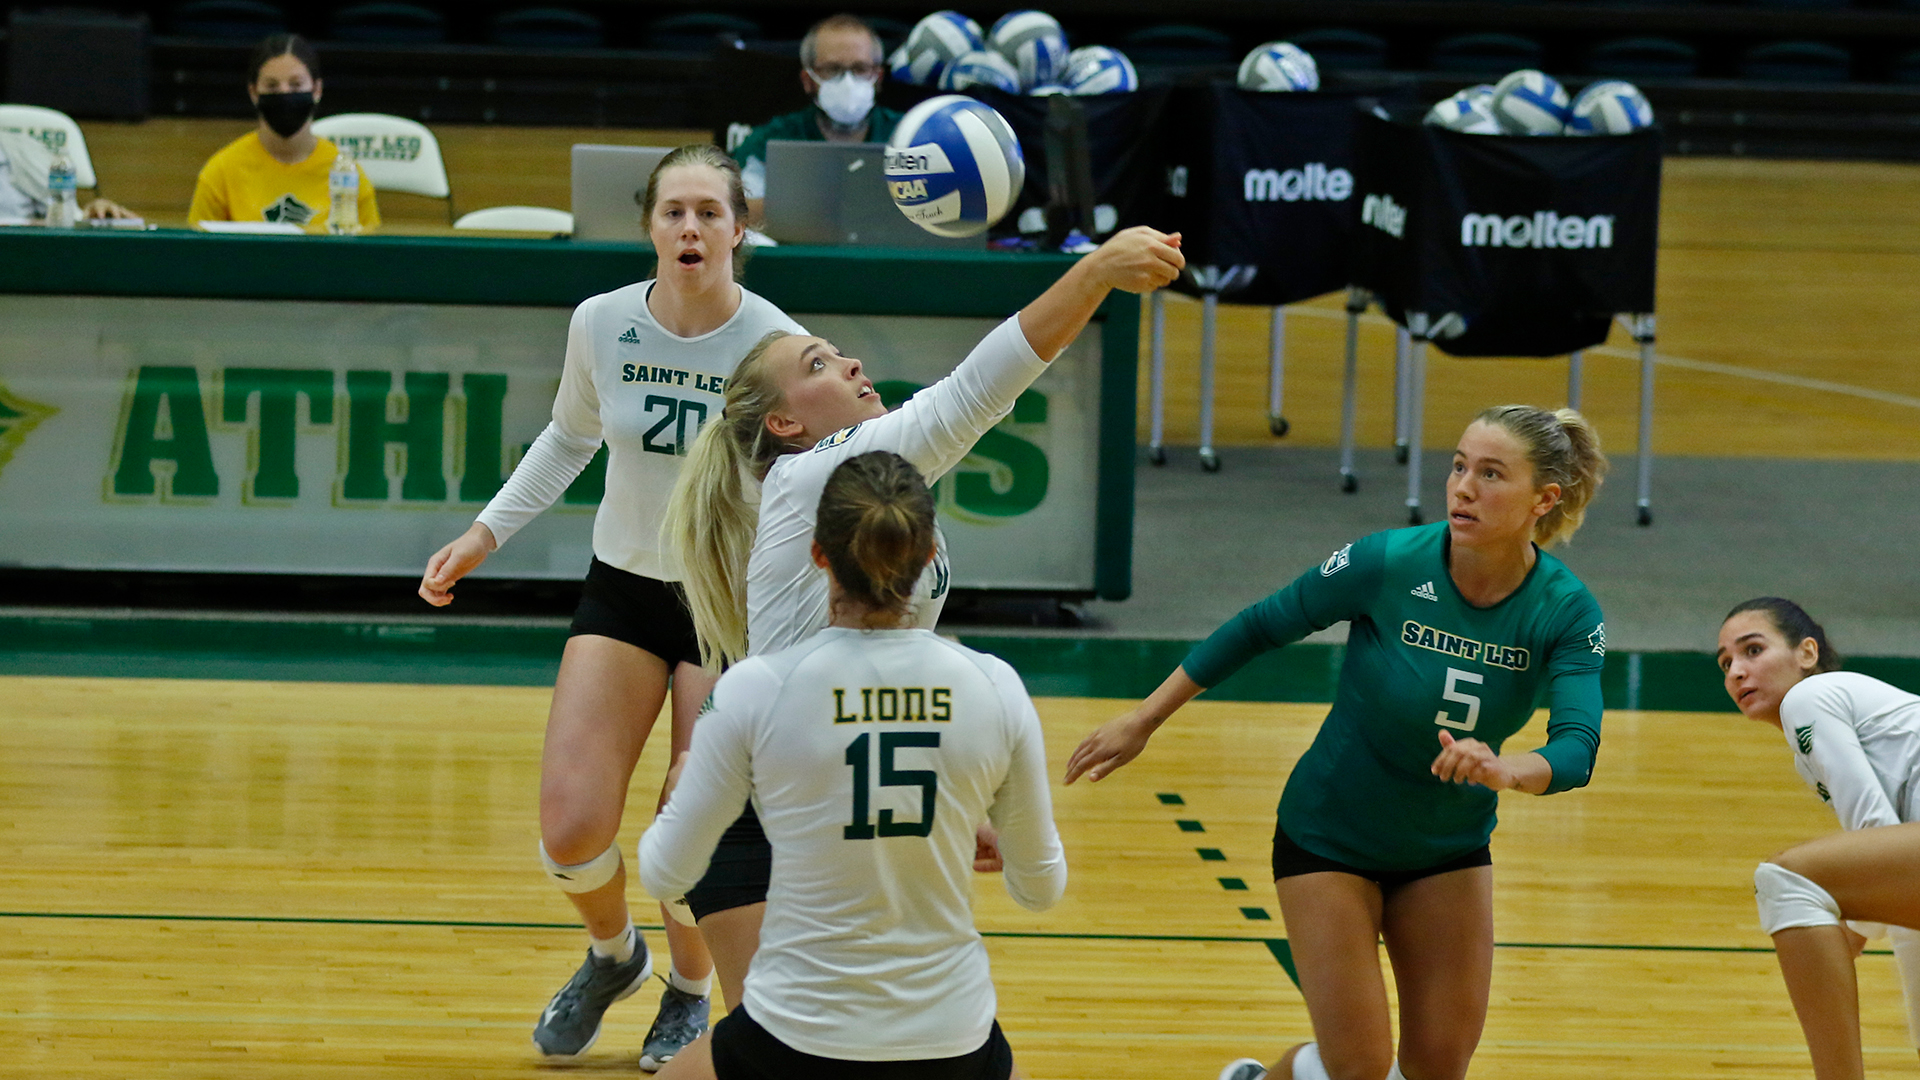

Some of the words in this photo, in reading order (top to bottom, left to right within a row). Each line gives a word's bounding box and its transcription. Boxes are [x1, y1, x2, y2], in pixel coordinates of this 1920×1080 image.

[1244, 162, 1354, 202] molte
[1461, 210, 1614, 249] molten
[621, 362, 690, 387] SAINT
[103, 365, 1050, 520] ATHLS
[642, 394, 708, 456] 20
[1411, 589, 1438, 602] adidas
[1401, 620, 1482, 661] SAINT
[1483, 643, 1530, 671] LEO
[833, 687, 952, 724] LIONS
[1434, 667, 1484, 732] 5
[844, 731, 941, 839] 15
